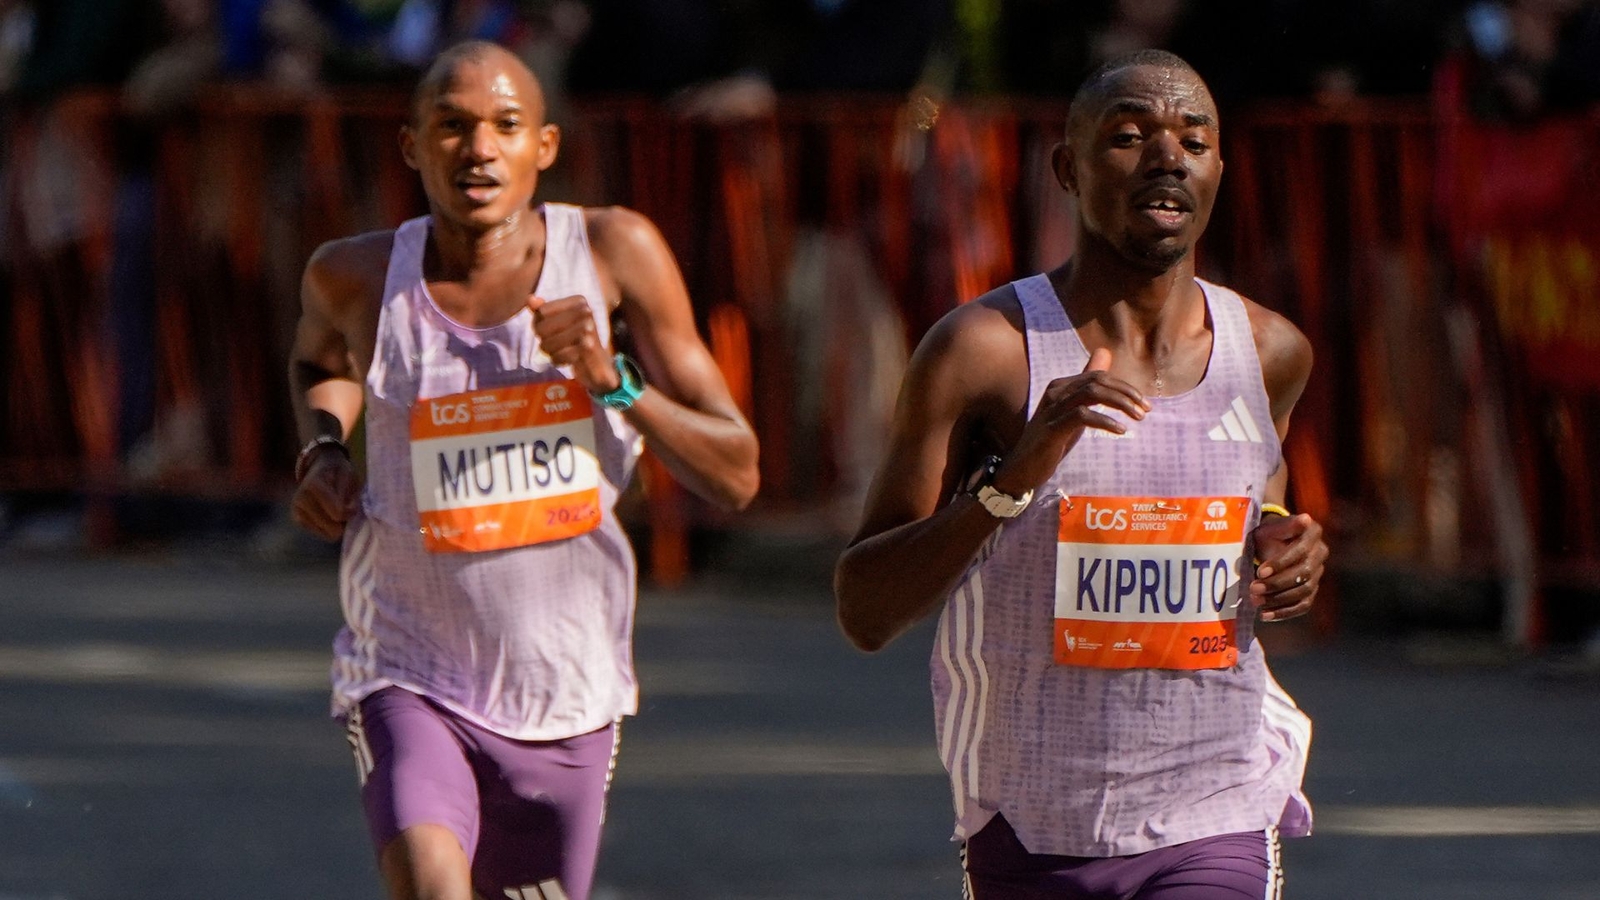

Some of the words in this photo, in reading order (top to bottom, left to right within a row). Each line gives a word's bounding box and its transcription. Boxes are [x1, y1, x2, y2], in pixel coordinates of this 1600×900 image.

[430, 401, 471, 426] tcs
[543, 401, 572, 413] TATA
[437, 436, 576, 501] MUTISO
[1085, 502, 1128, 531] tcs
[1131, 513, 1188, 522] CONSULTANCY
[1203, 521, 1229, 531] TATA
[1130, 522, 1167, 531] SERVICES
[1076, 557, 1229, 614] KIPRUTO
[1189, 635, 1229, 654] 2025
